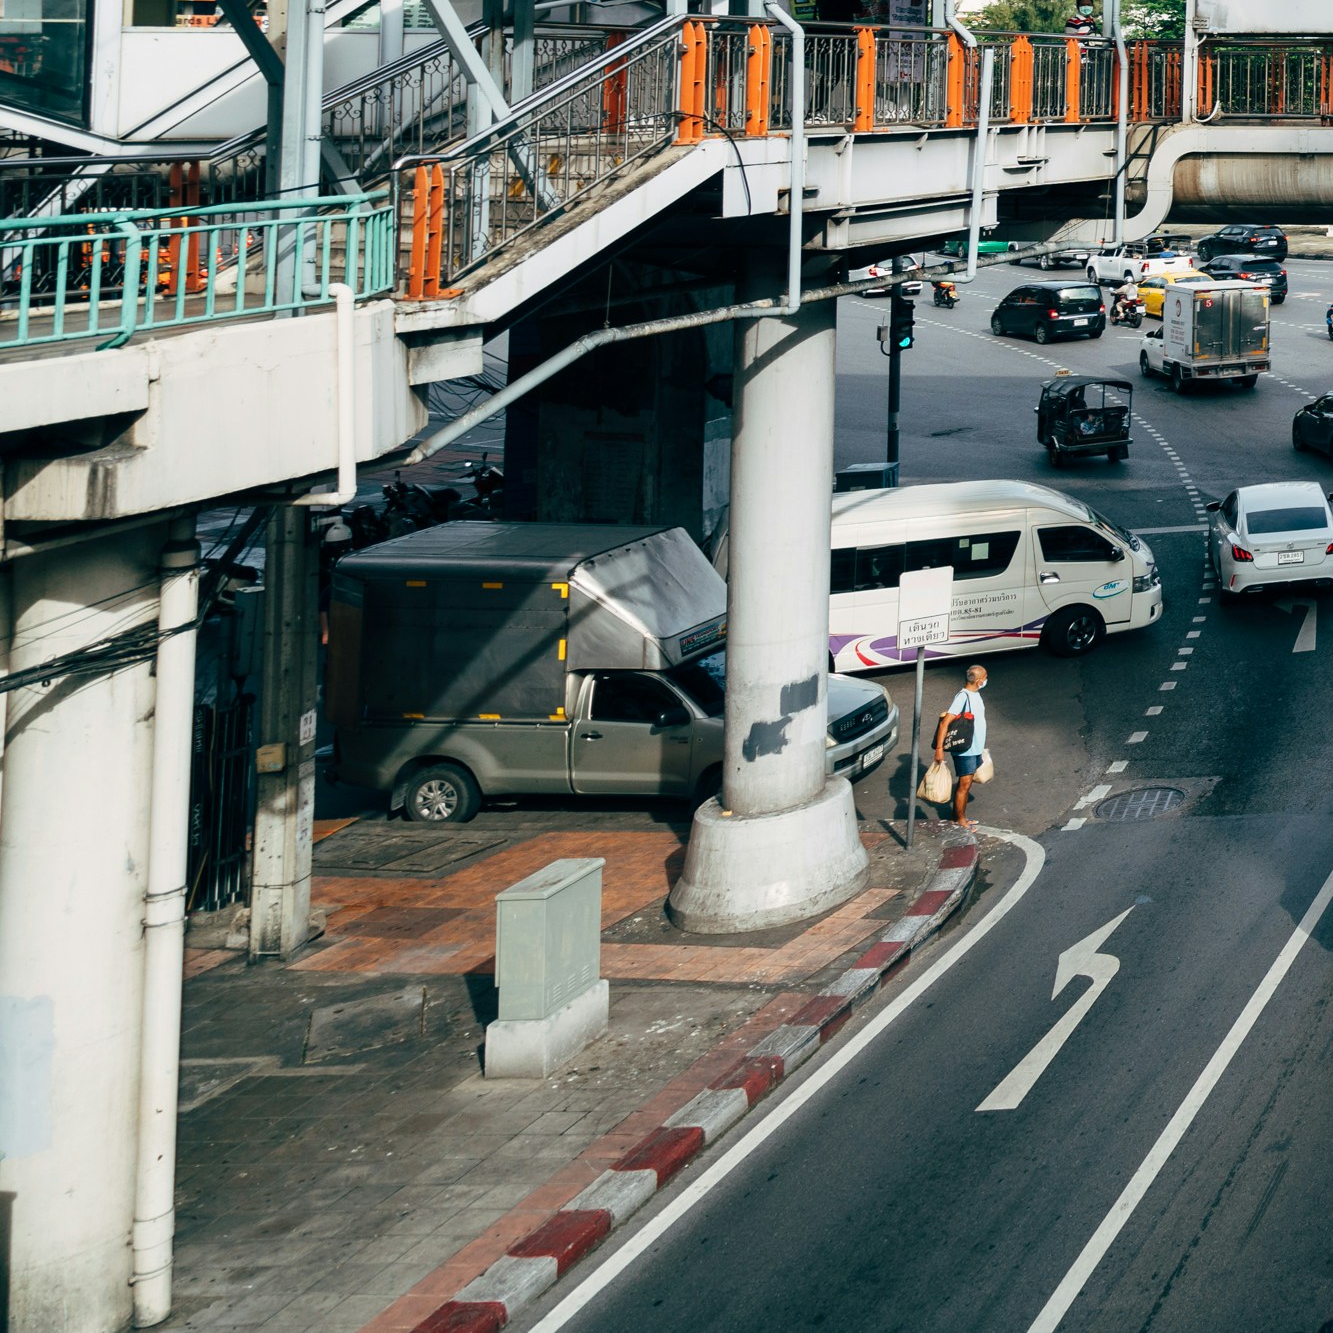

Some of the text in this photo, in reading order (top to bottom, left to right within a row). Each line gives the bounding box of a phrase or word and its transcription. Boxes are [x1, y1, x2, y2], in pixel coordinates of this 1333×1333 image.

[909, 622, 940, 632] เดินรถ
[904, 631, 945, 645] ทางเดียว
